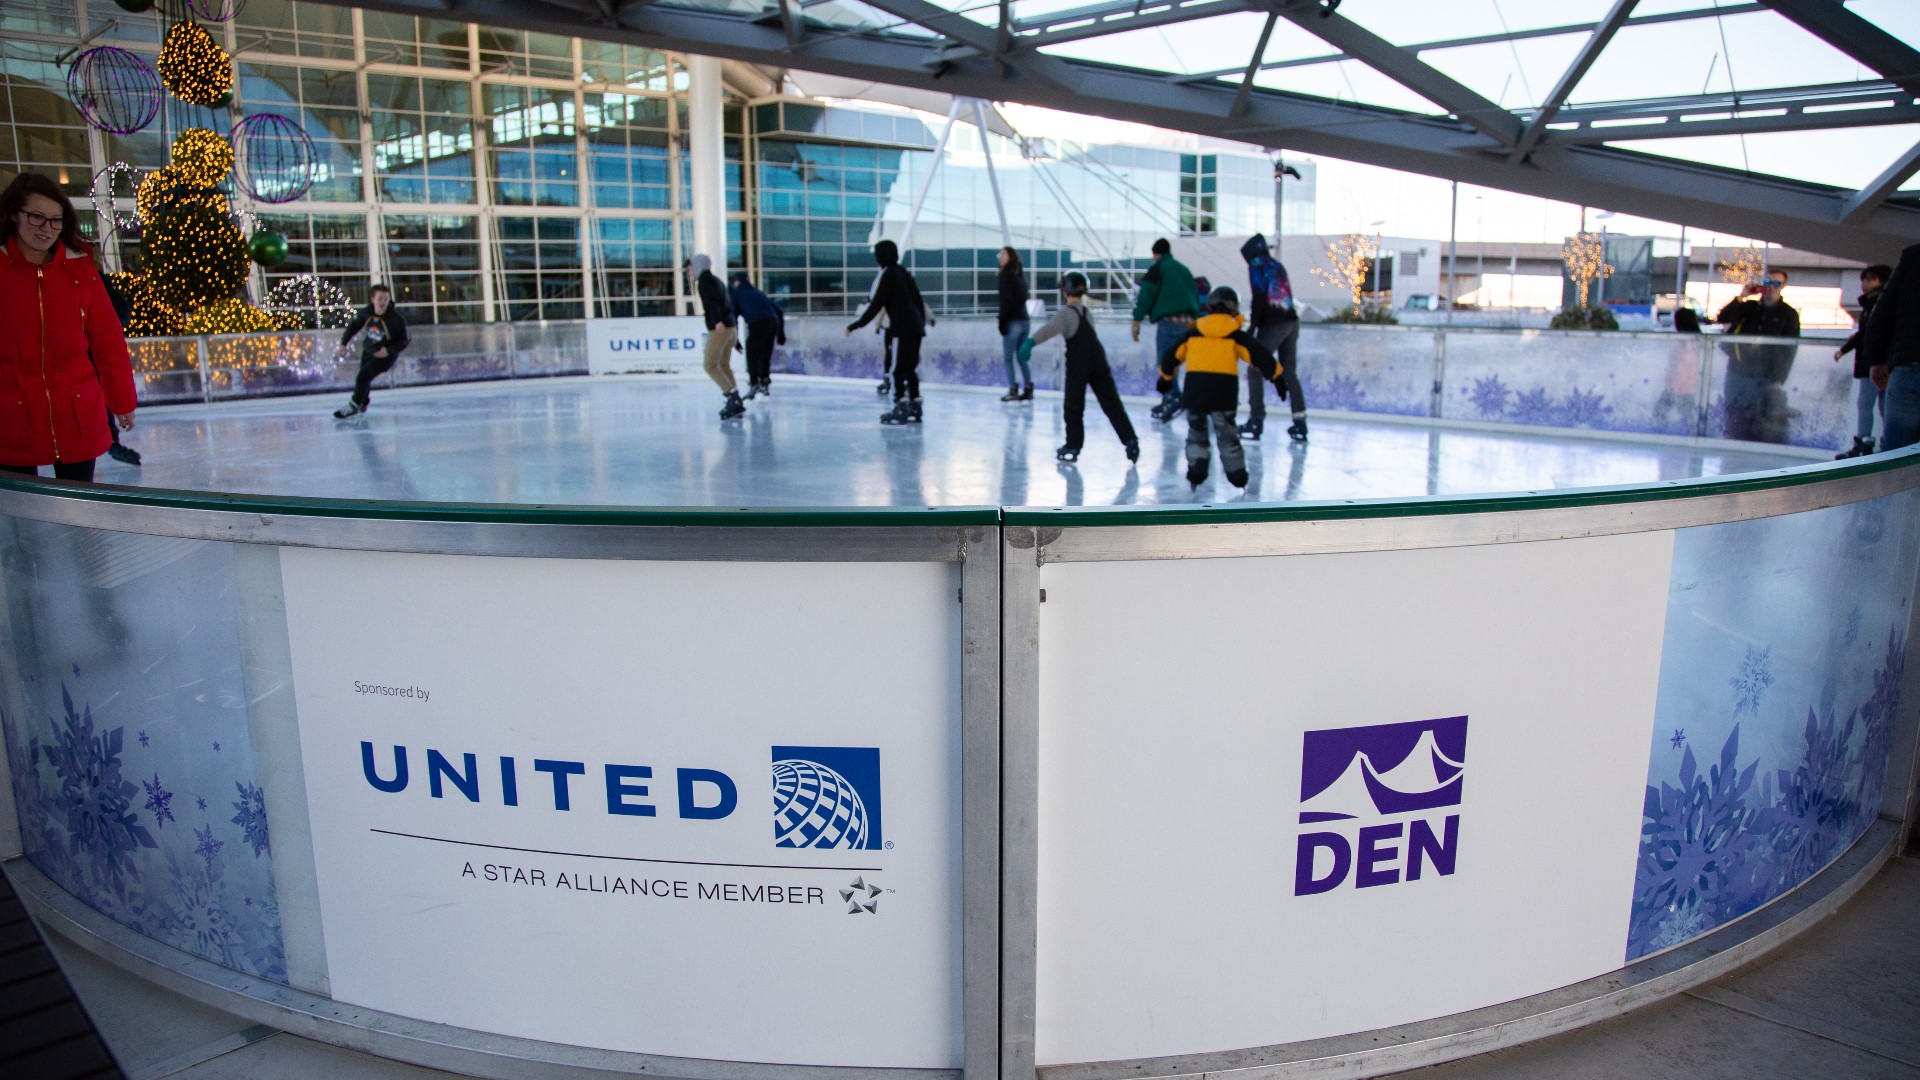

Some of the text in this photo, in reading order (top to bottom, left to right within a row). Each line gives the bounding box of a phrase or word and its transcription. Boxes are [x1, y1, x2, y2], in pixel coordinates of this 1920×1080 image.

[609, 338, 696, 352] UNITED
[354, 680, 430, 702] Sponsored by
[361, 741, 738, 820] UNITED
[1294, 814, 1460, 896] DEN
[461, 861, 824, 905] A STAR ALLIANCE MEMBER
